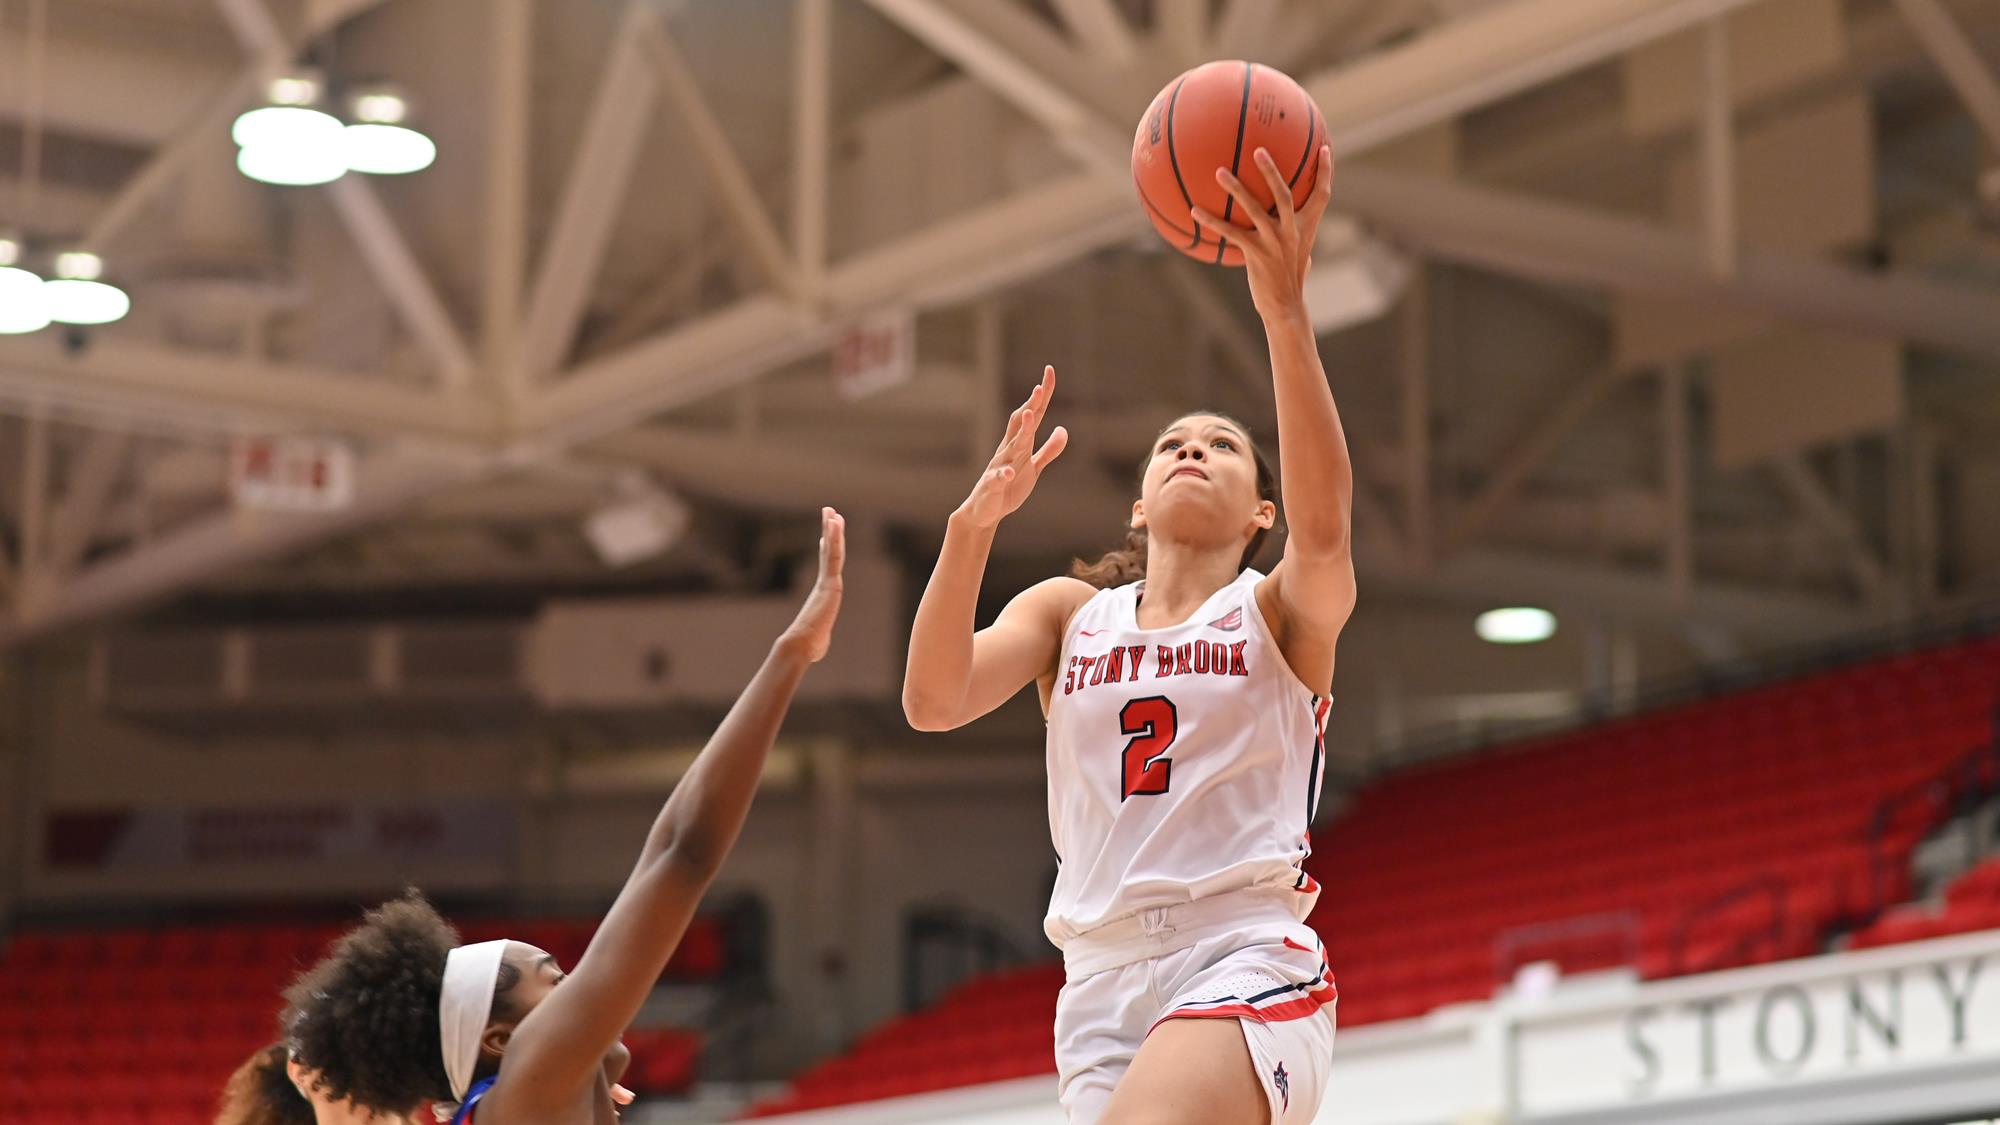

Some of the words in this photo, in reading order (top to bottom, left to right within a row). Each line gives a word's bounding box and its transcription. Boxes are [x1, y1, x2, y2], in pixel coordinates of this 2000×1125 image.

[1064, 645, 1146, 695] STONY
[1155, 639, 1248, 678] BROOK
[1119, 695, 1178, 803] 2
[1625, 957, 1984, 1093] STONY
